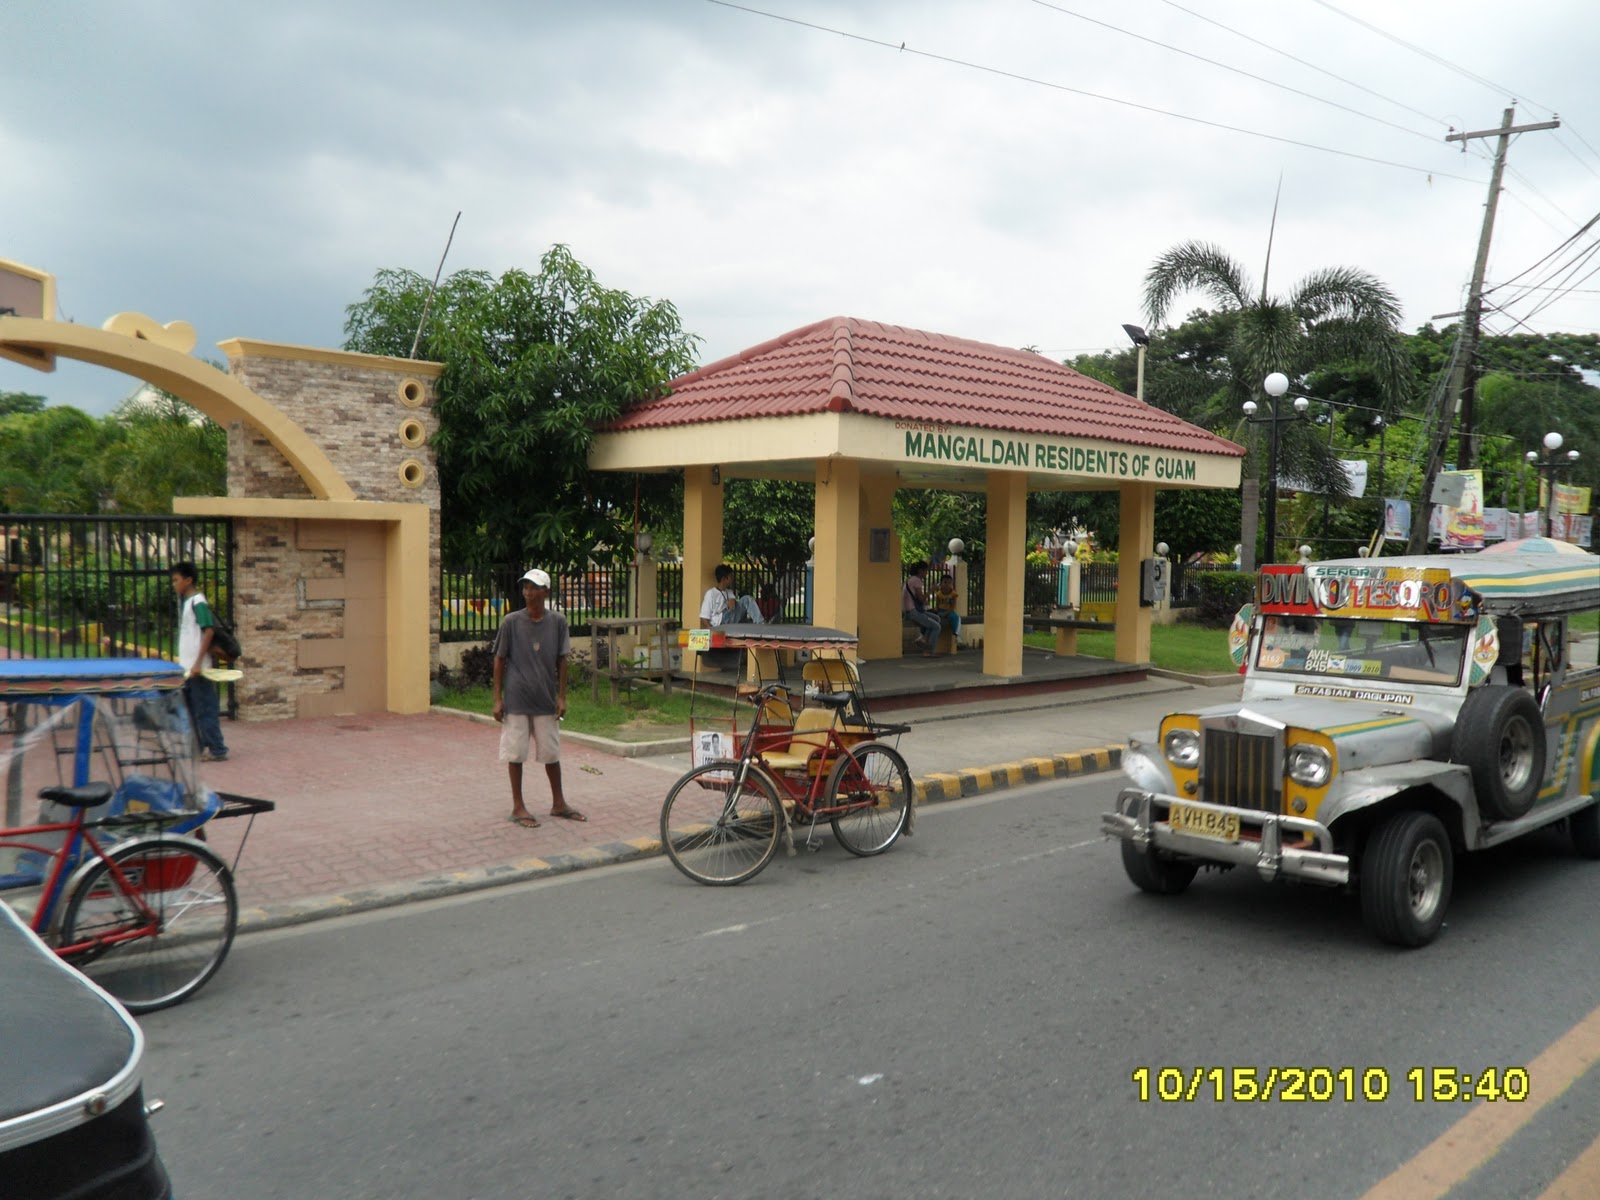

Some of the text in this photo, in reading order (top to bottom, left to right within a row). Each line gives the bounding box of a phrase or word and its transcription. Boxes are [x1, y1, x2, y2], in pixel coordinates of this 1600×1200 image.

[895, 421, 935, 432] DONATED
[905, 430, 1196, 480] MANGALDAN RESIDENTS OF GUAM
[1261, 573, 1454, 622] DIVINO TESORO
[1307, 649, 1330, 660] AVH
[1363, 665, 1381, 674] 2010
[1206, 812, 1237, 833] 845
